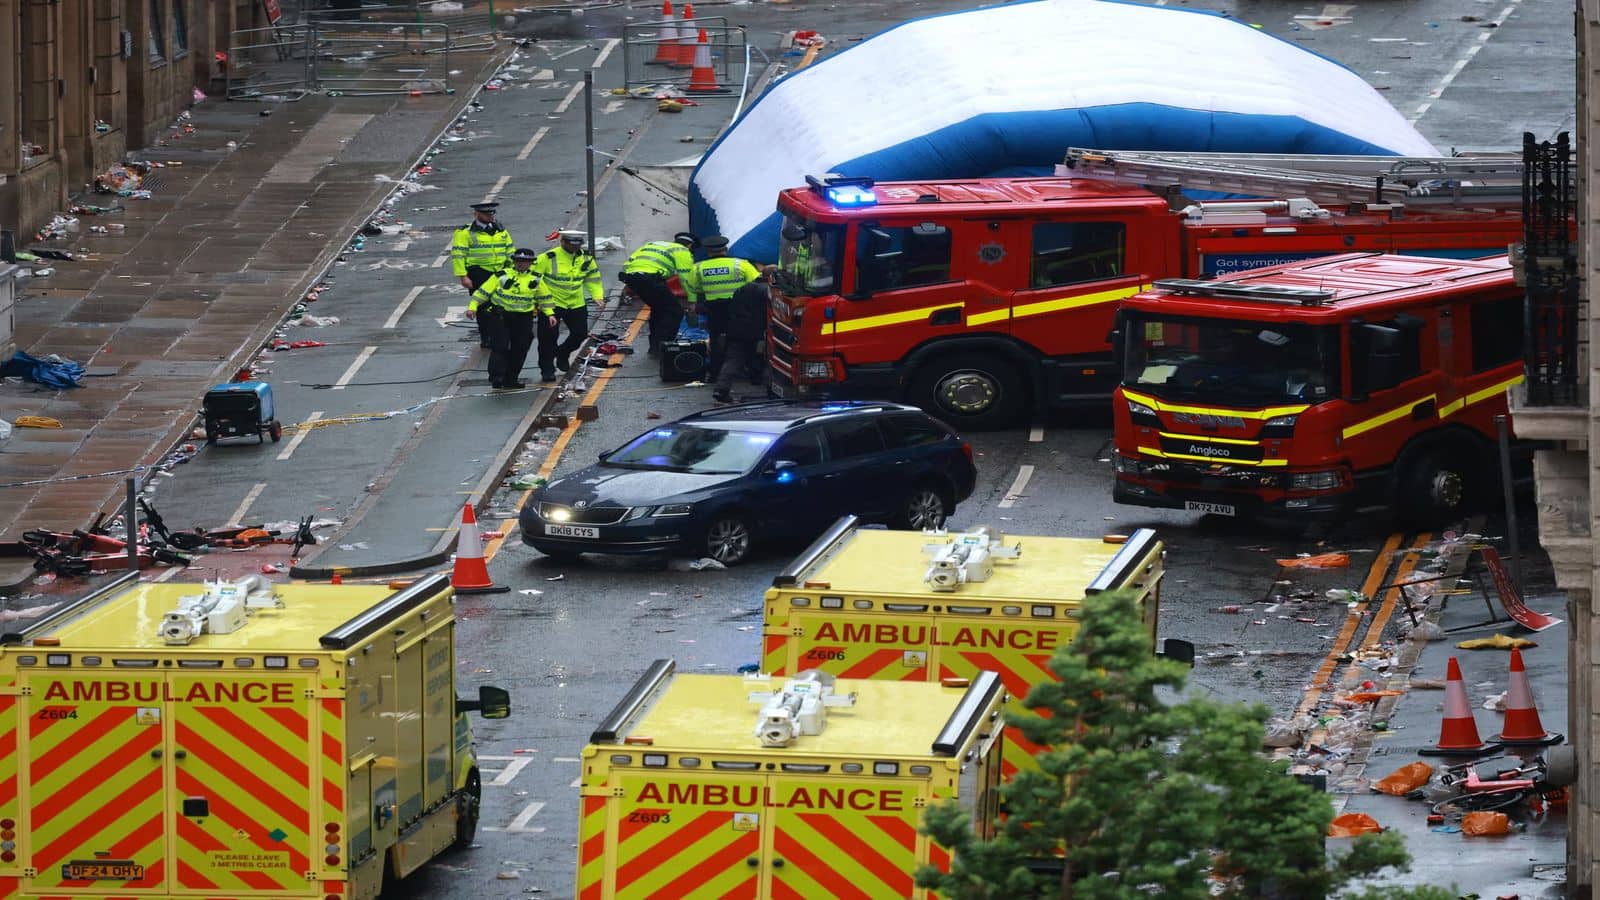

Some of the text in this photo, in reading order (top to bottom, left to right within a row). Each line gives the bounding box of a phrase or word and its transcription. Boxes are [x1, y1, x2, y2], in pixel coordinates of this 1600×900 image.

[1216, 259, 1239, 267] Got
[1189, 444, 1230, 457] Angloco
[1189, 502, 1231, 514] DK72 AVU
[550, 526, 594, 537] DK18 CYS
[813, 621, 1059, 650] AMBULANCE
[807, 650, 846, 661] Z606
[44, 680, 295, 703] AMBULANCE
[38, 709, 79, 720] Z604
[635, 782, 904, 811] AMBULANCE
[628, 812, 672, 824] Z603
[71, 865, 108, 876] DF24
